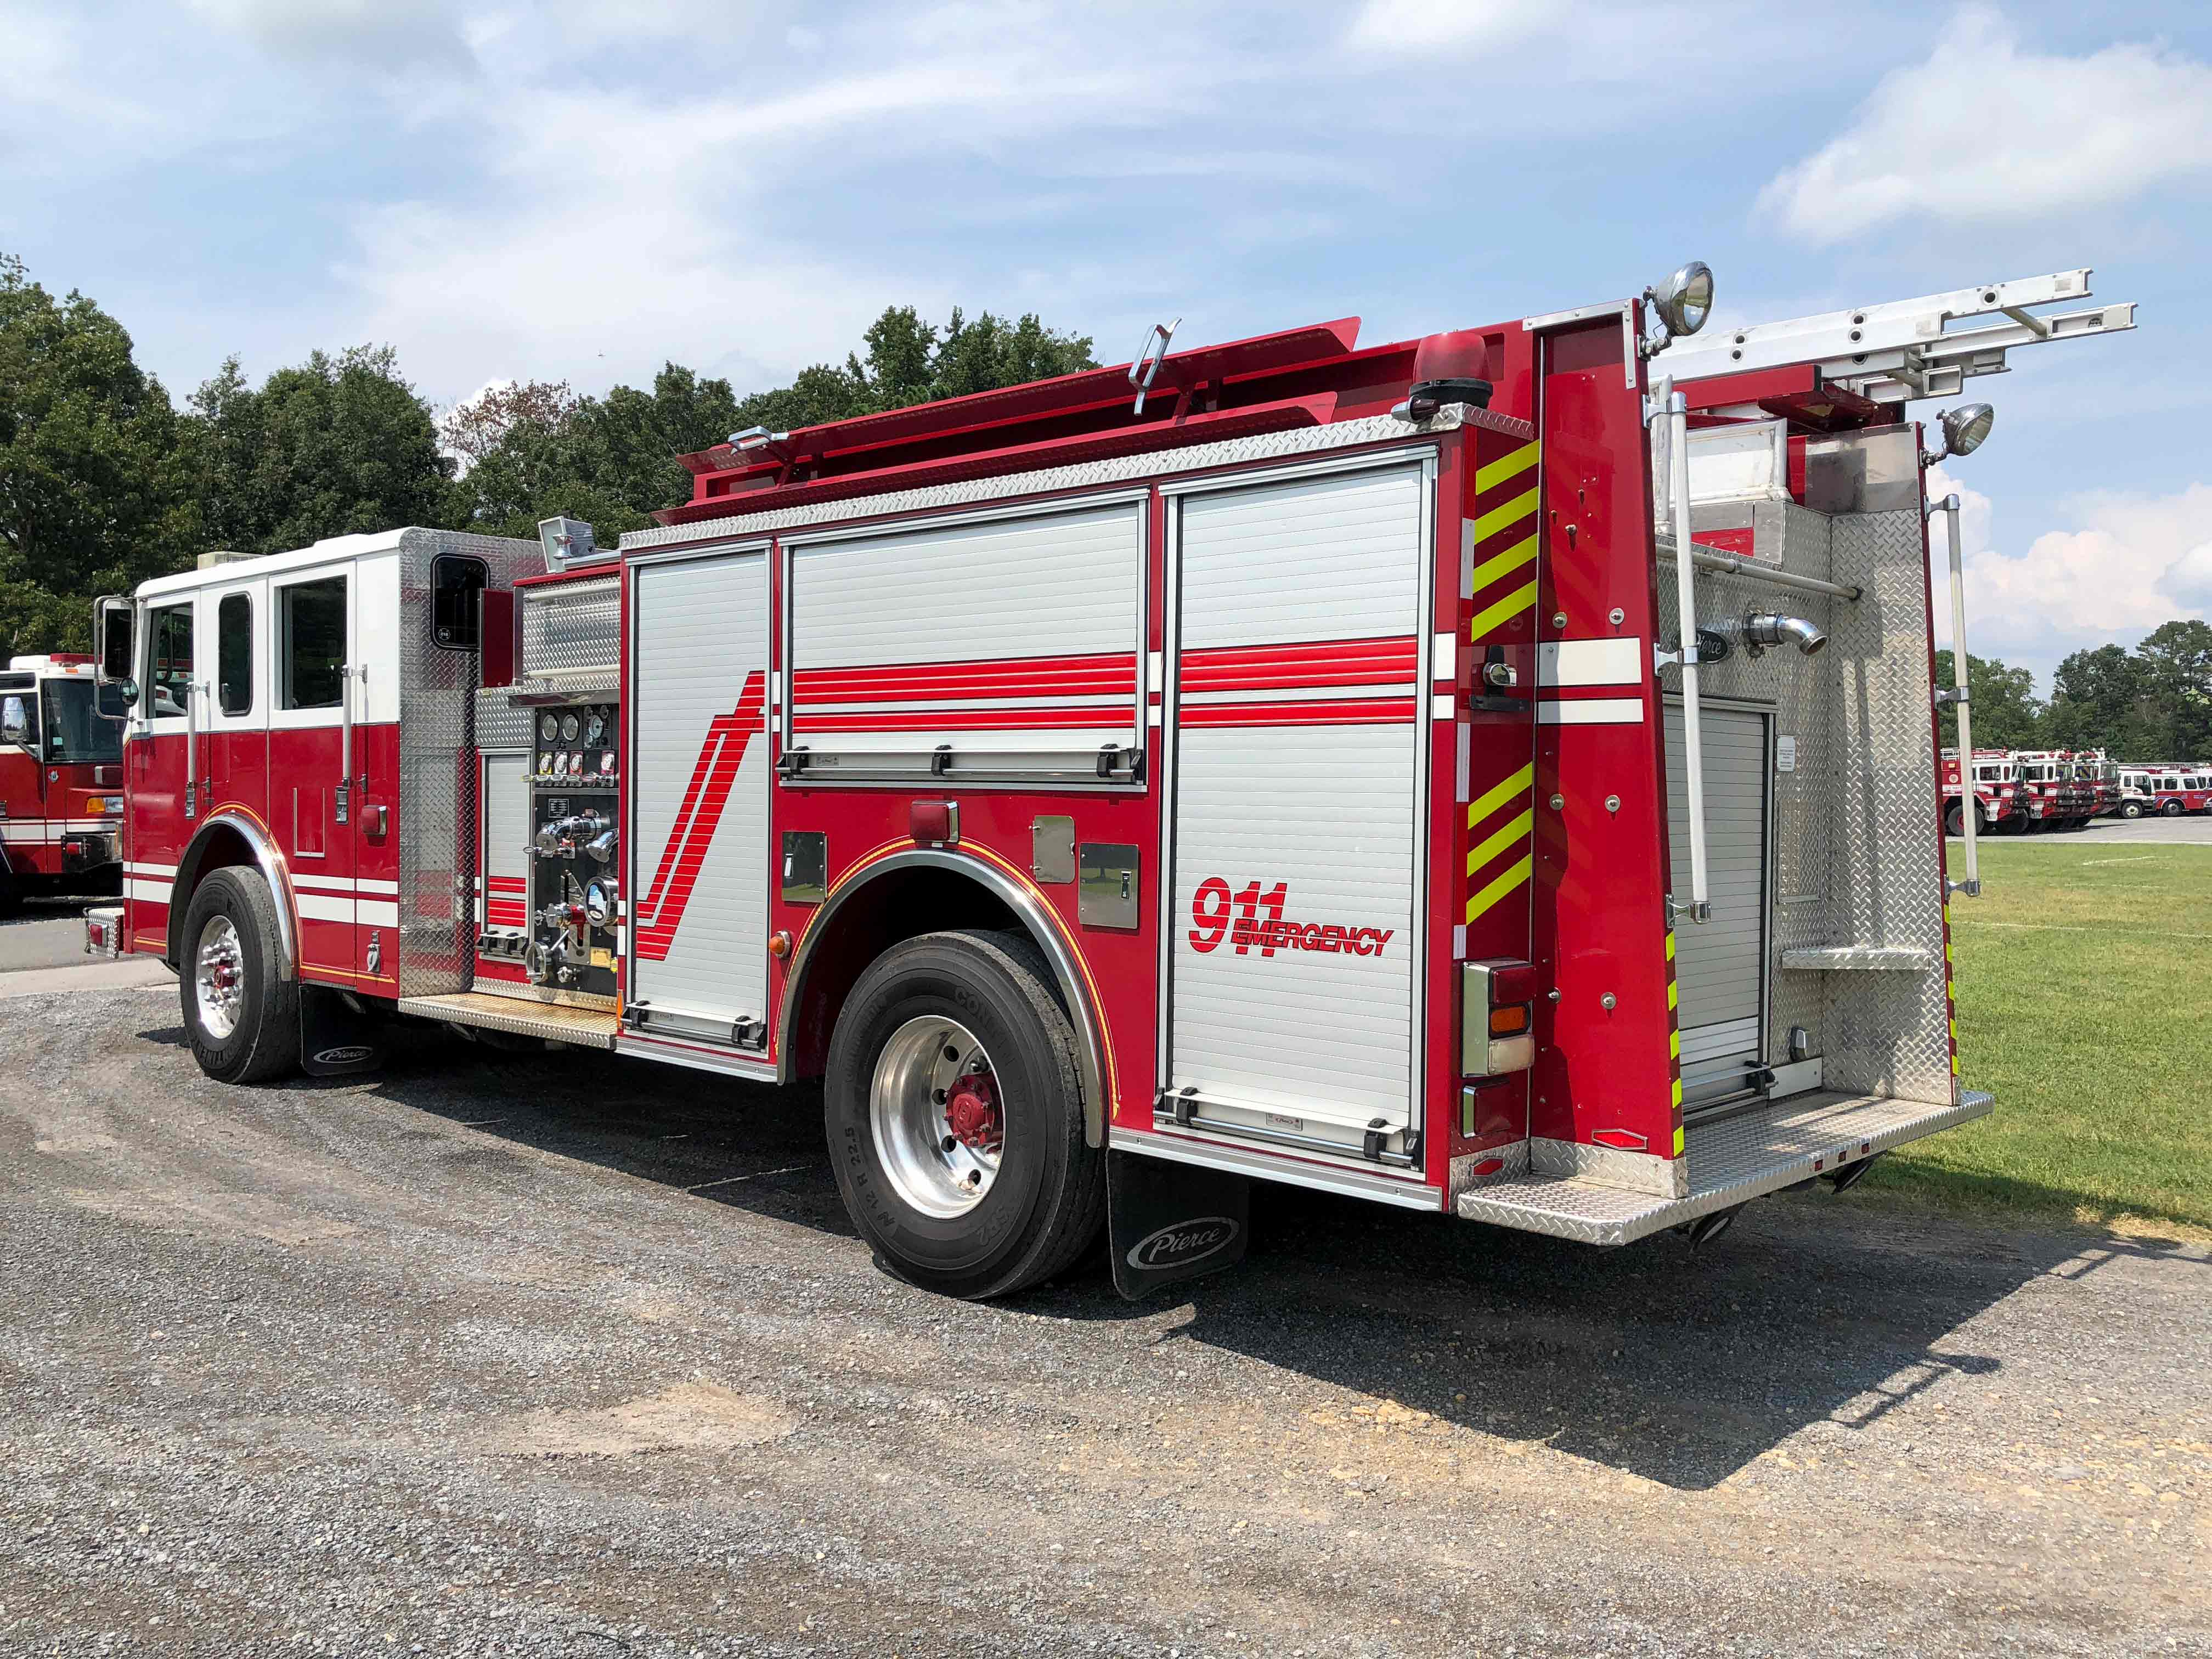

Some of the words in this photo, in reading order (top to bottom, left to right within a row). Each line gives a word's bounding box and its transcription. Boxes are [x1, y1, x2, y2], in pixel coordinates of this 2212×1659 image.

[1188, 877, 1288, 957] 911
[1231, 918, 1395, 956] EMERGENCY
[1148, 1228, 1220, 1262] Pierce
